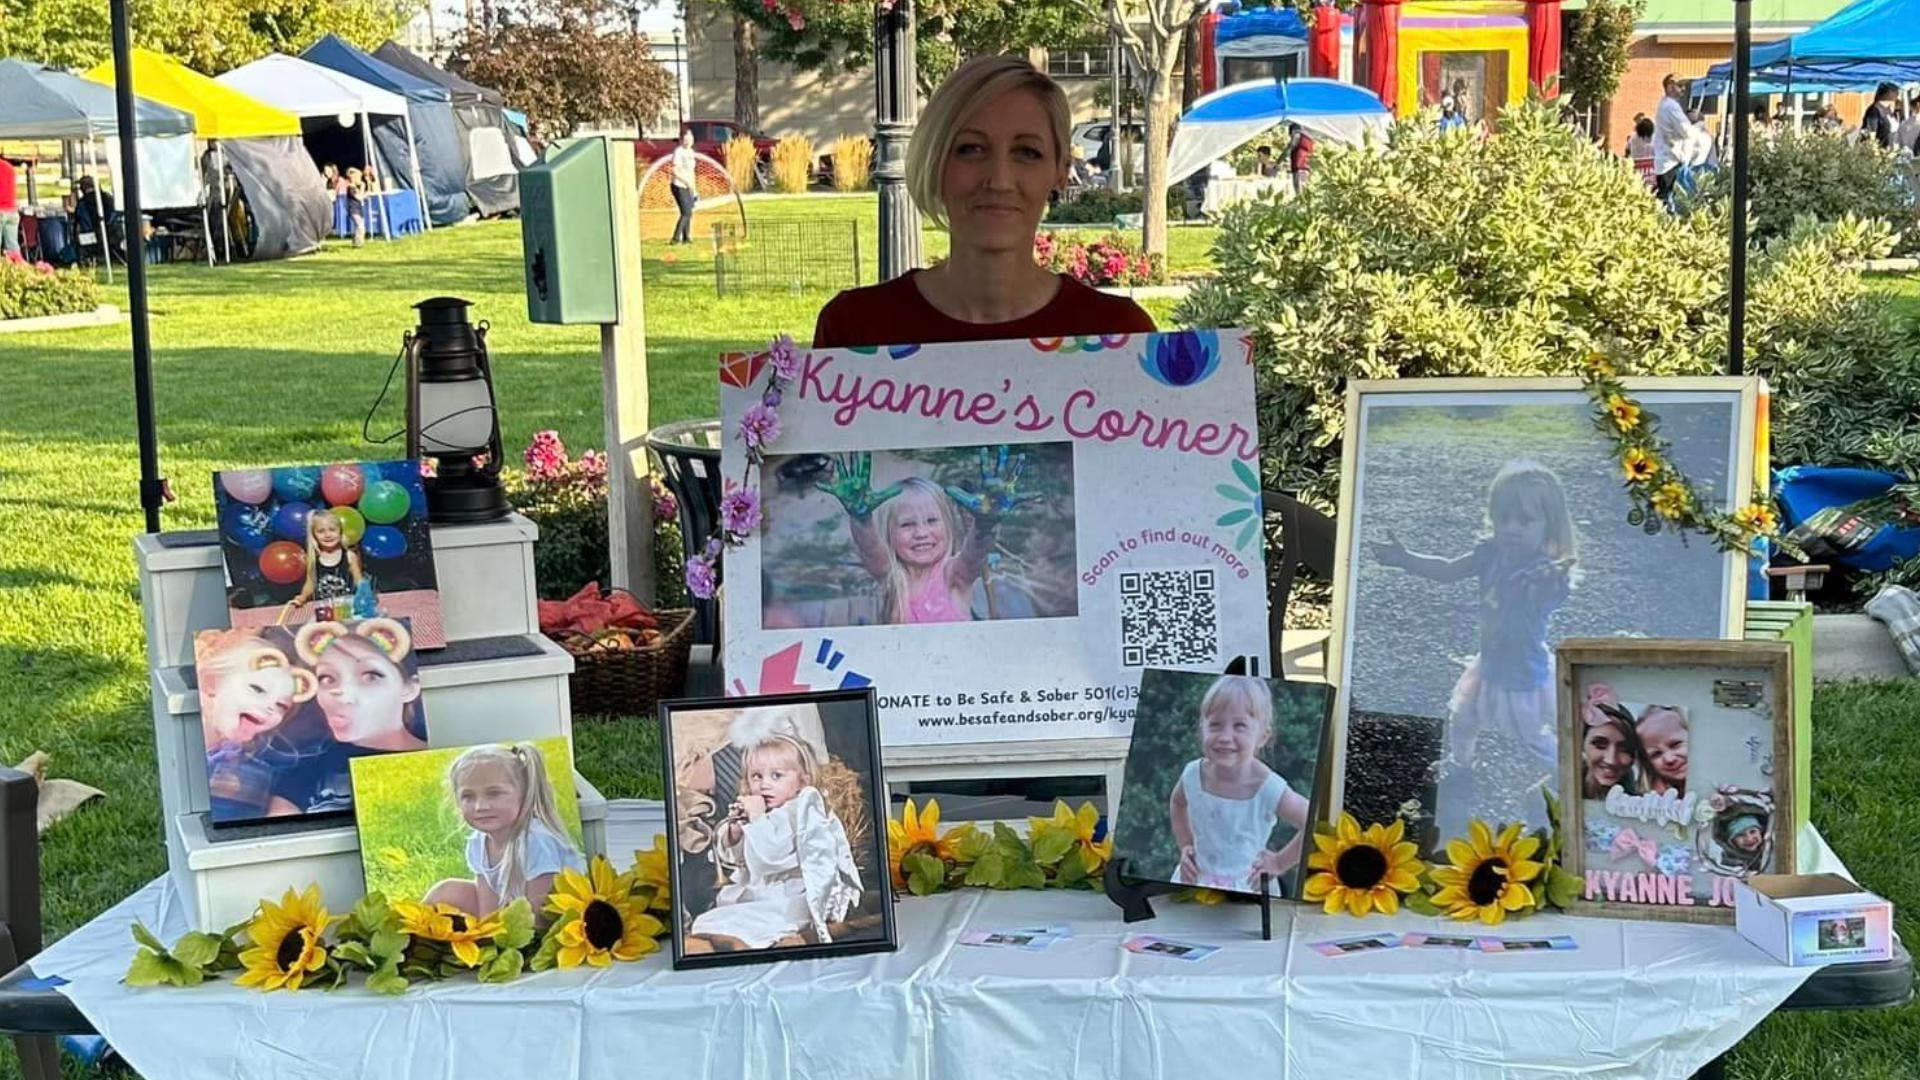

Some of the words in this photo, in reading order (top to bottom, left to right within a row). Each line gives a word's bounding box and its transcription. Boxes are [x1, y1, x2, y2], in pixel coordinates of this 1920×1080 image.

[799, 353, 1054, 431] Kyanne's
[1063, 389, 1259, 461] Corner
[1082, 550, 1119, 586] Scan
[1119, 538, 1138, 553] to
[1141, 527, 1176, 544] find
[1181, 531, 1210, 549] out
[1212, 543, 1249, 580] more
[878, 694, 930, 709] ONATE
[936, 695, 952, 706] to
[957, 693, 975, 705] Be
[980, 690, 1014, 704] Safe
[1020, 690, 1031, 703] &
[1036, 686, 1079, 702] Sober
[1085, 685, 1139, 701] 501(c)3
[918, 706, 1136, 727] www.besafeandsober.org/kya
[1585, 870, 1695, 904] KYANNE
